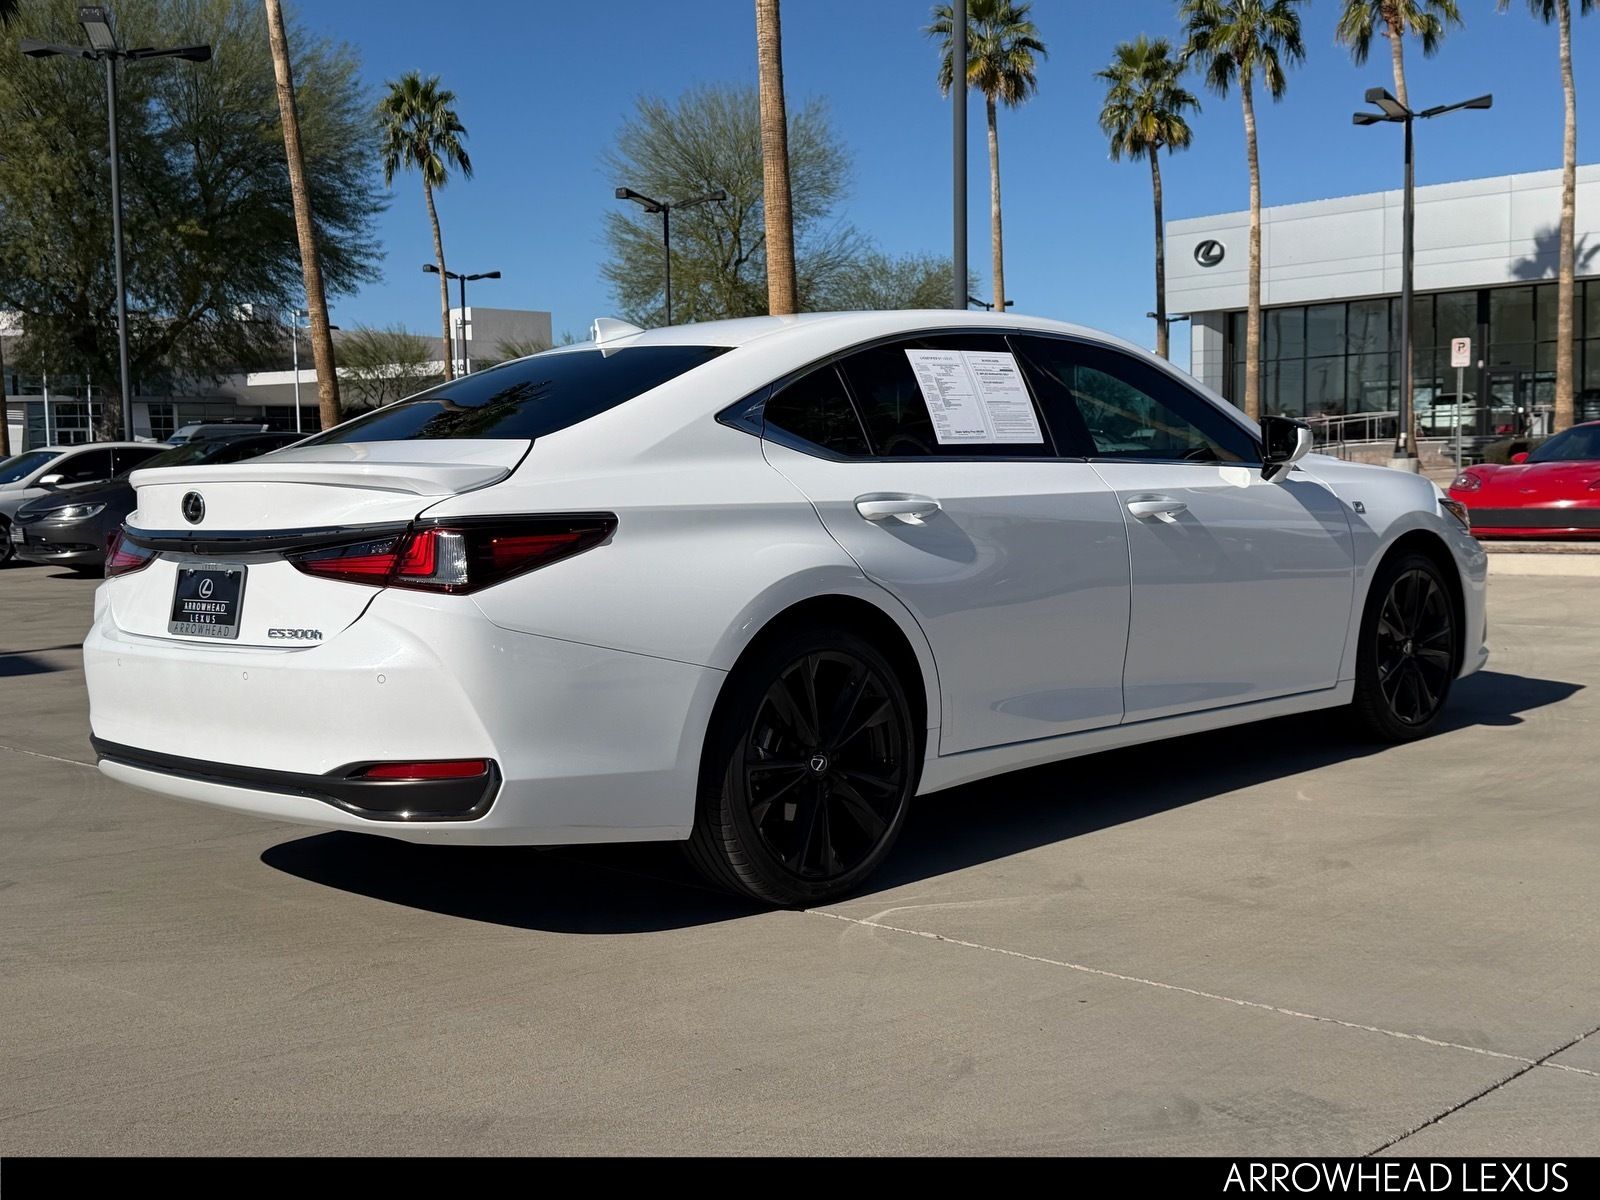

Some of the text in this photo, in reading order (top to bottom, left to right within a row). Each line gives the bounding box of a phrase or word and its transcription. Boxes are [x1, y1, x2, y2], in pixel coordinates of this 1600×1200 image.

[184, 602, 226, 613] ARROWHEAD
[190, 614, 216, 624] LEXUS
[174, 624, 230, 637] ARROWHEAD
[268, 628, 323, 641] ES300h
